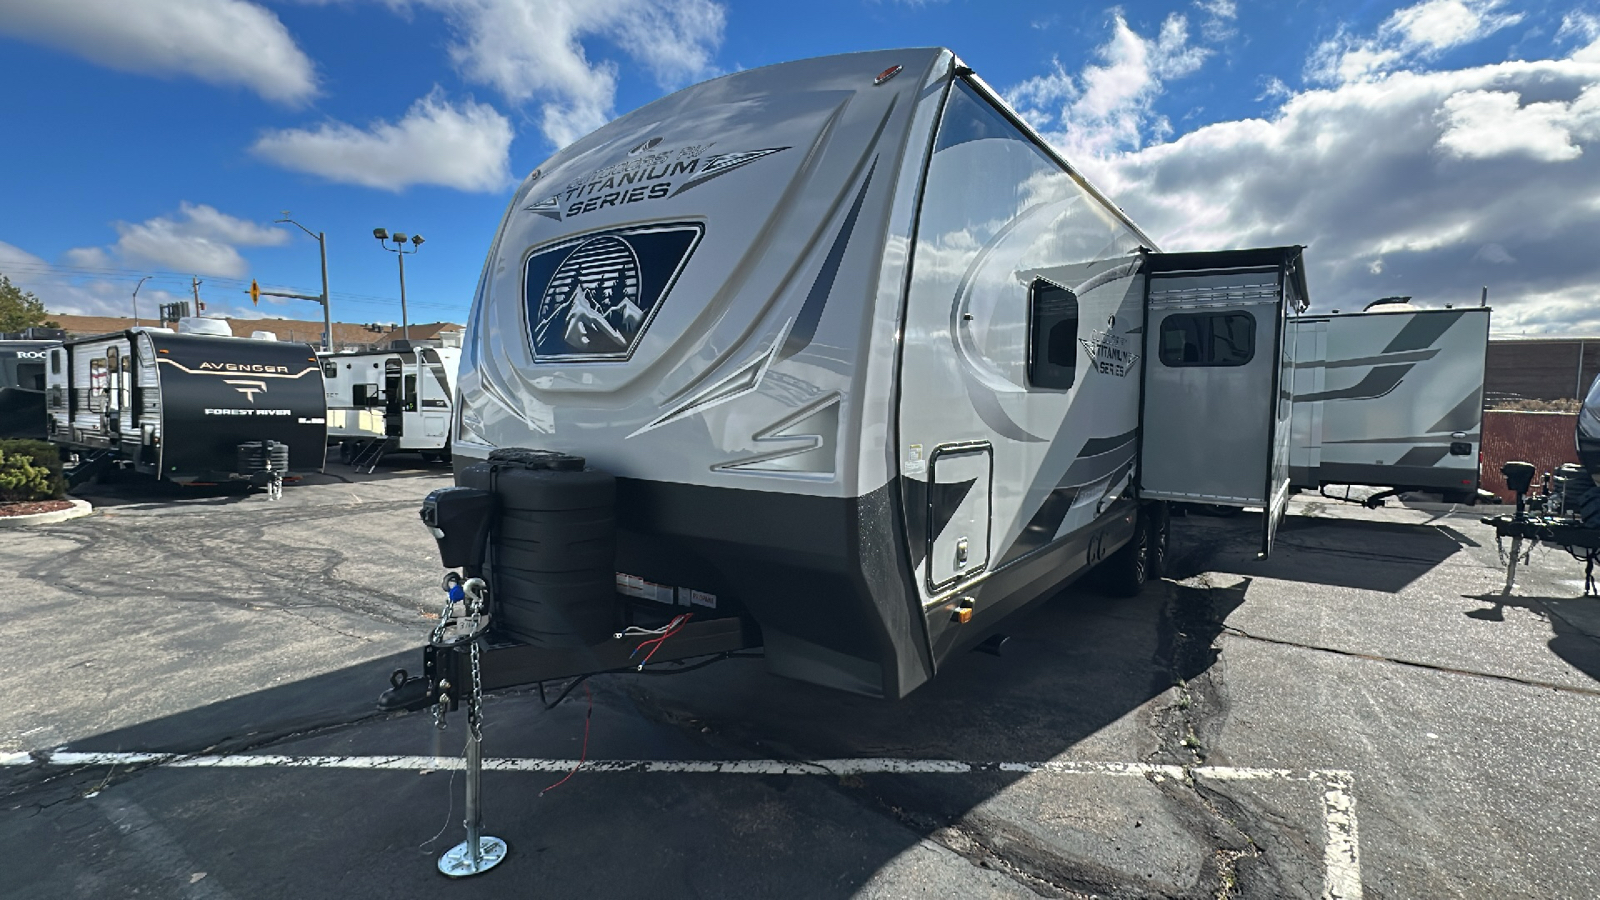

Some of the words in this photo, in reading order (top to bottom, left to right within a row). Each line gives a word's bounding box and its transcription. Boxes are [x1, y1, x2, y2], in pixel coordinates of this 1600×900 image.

[565, 158, 700, 202] TITANIUM
[566, 182, 671, 218] SERIES
[200, 361, 289, 374] AVENGER
[1100, 361, 1124, 378] SERES
[204, 408, 254, 416] FOREST
[255, 409, 292, 417] RIVER
